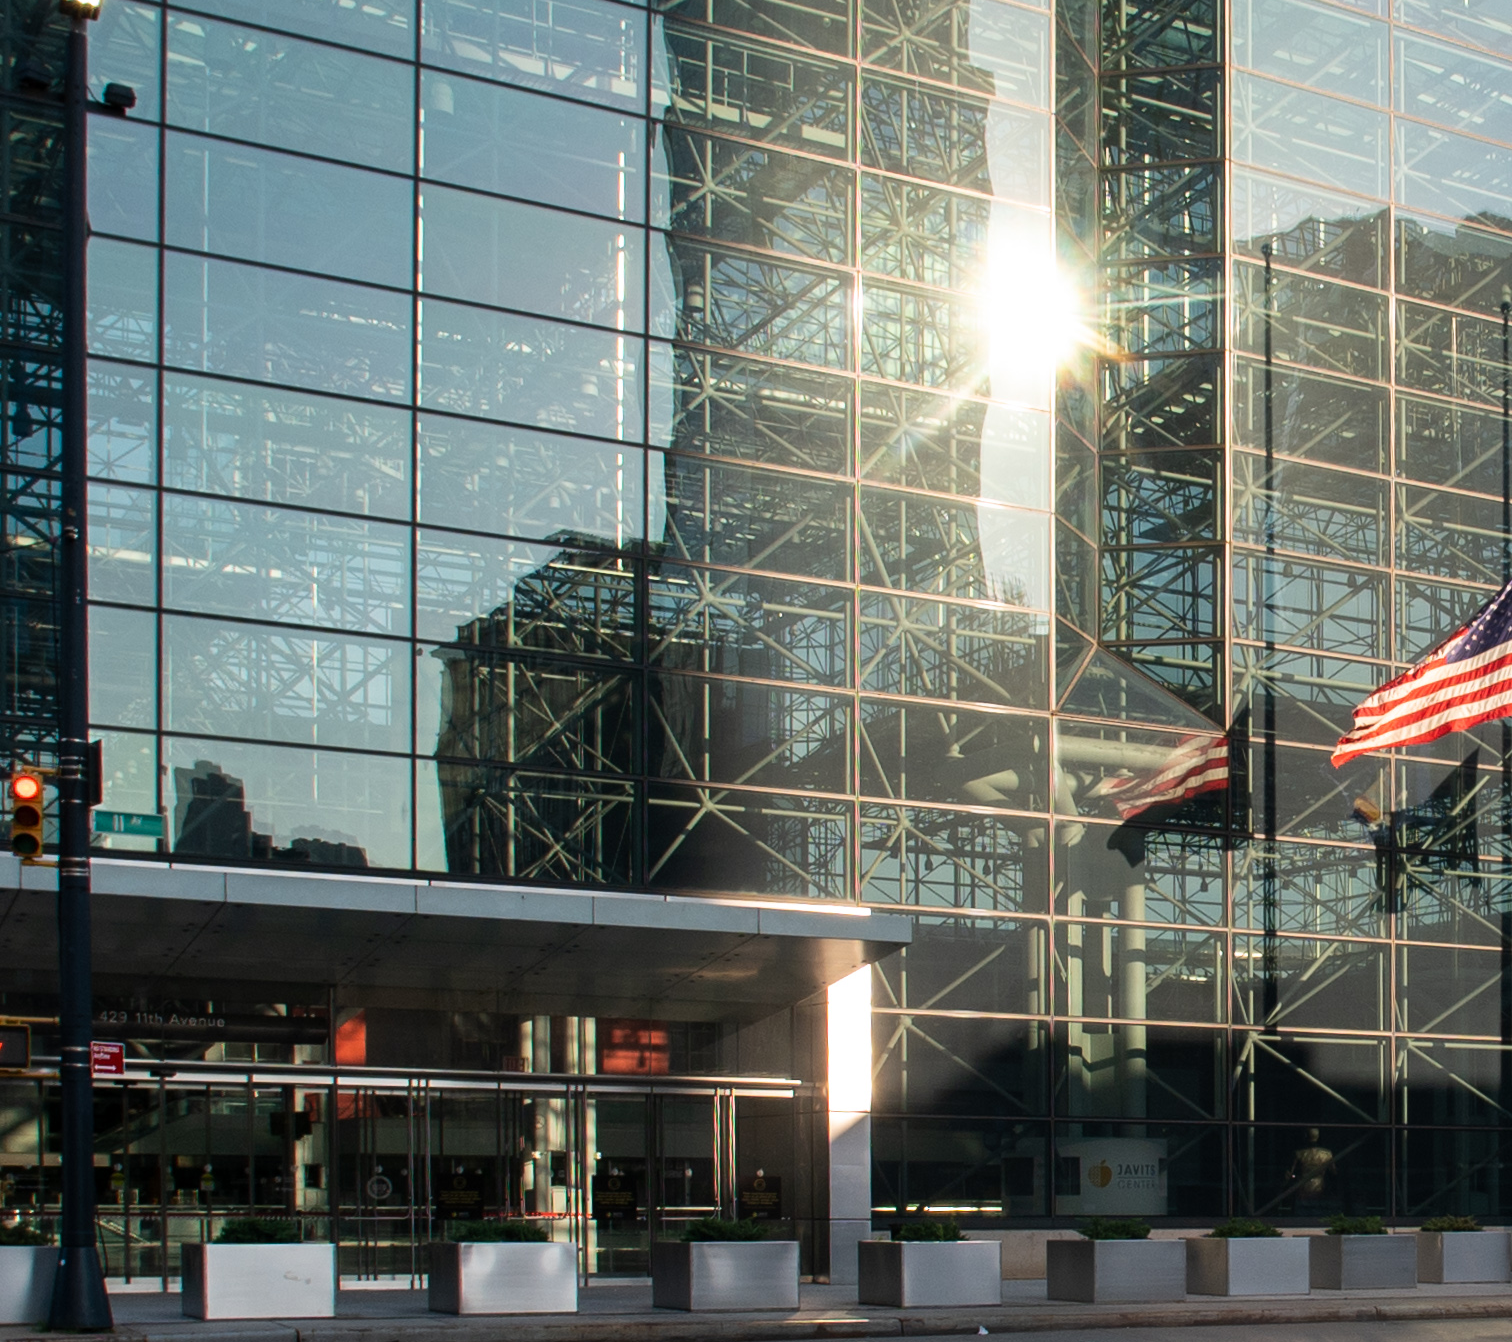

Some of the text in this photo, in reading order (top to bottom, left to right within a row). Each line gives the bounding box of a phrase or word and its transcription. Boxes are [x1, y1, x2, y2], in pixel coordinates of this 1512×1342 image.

[112, 814, 125, 832] 11
[100, 1011, 226, 1028] 429 11th Avenue
[1117, 1164, 1156, 1177] JAVITS
